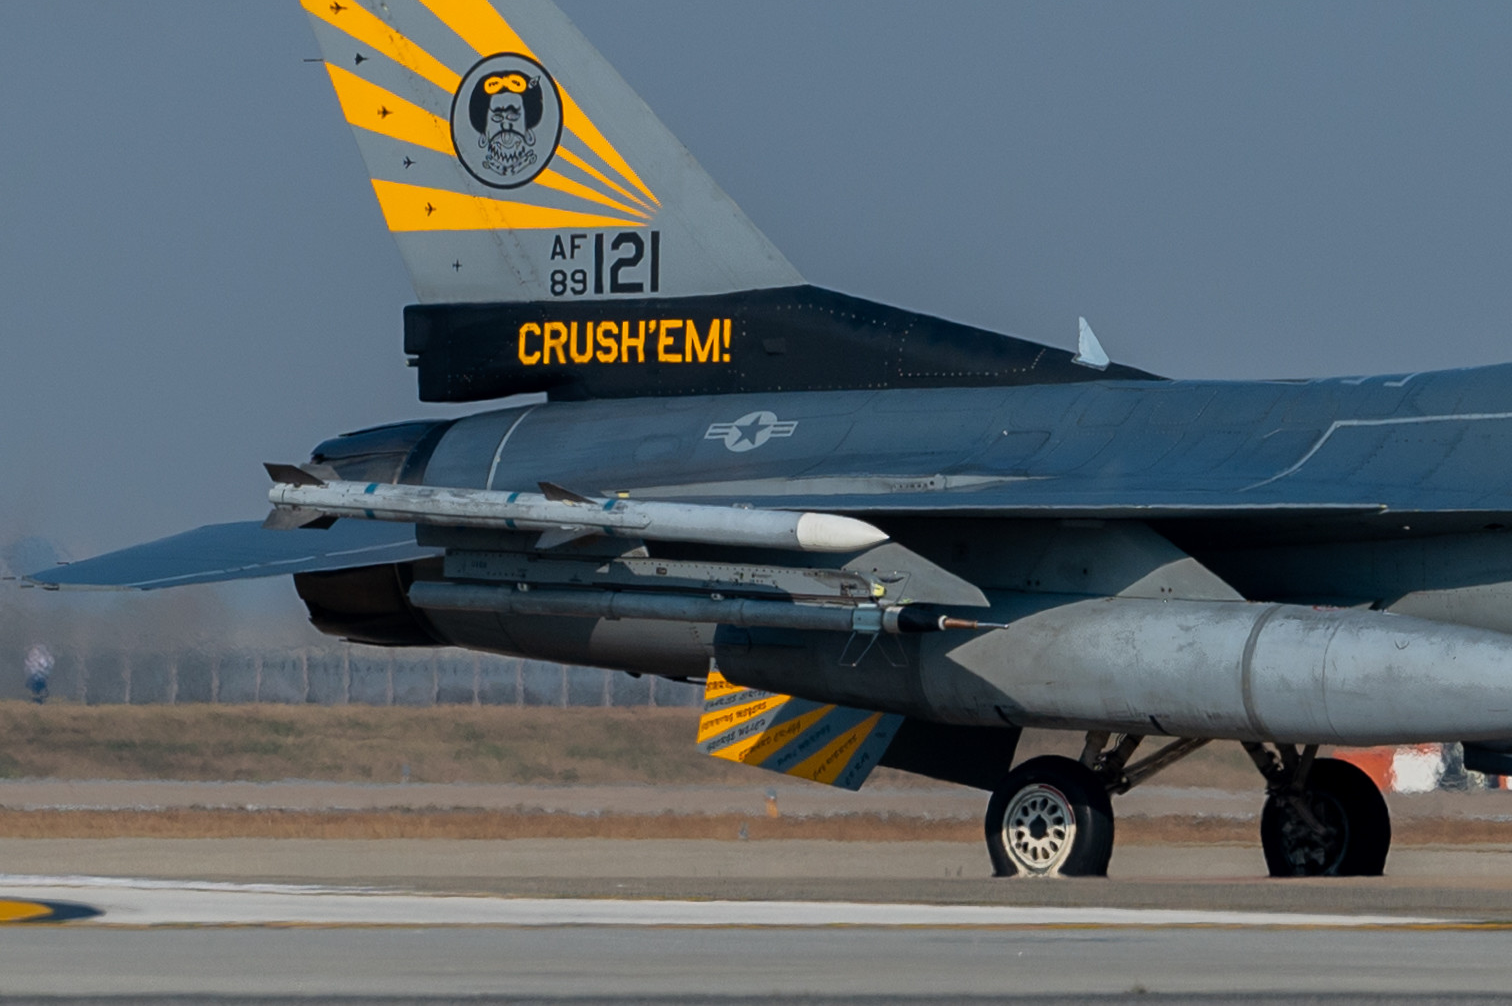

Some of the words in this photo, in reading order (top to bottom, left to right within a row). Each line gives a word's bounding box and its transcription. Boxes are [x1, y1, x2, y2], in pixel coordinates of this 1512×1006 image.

[550, 234, 587, 260] AF
[594, 231, 660, 294] 121
[550, 269, 587, 296] 89
[518, 318, 732, 365] CRUSH'EM!
